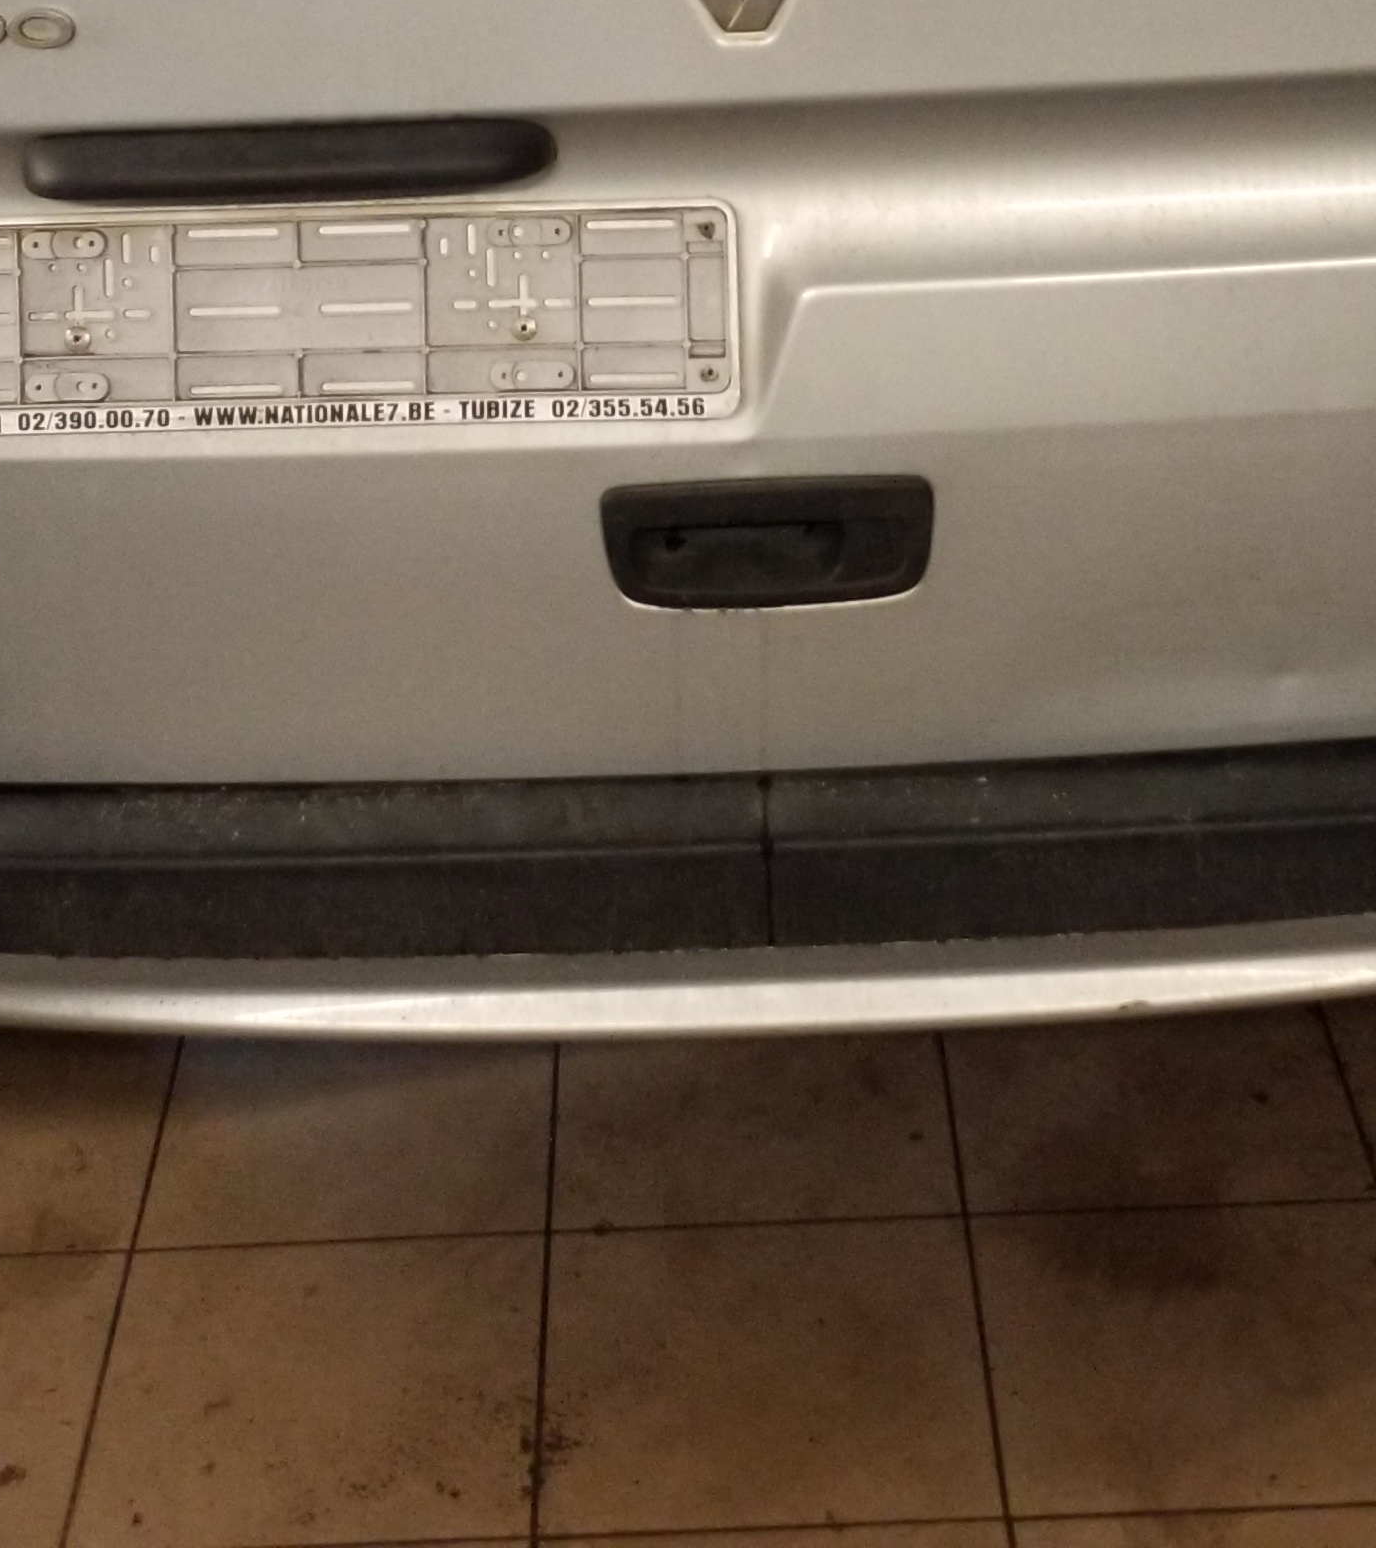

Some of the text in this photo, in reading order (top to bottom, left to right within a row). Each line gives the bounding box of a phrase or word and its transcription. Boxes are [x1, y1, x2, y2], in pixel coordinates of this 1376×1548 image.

[18, 408, 170, 432] 02/390.00.70
[193, 402, 436, 426] WWW.NATIONALE7.BE
[458, 399, 536, 420] TUBIZE
[551, 397, 706, 419] 02/355.54.56
